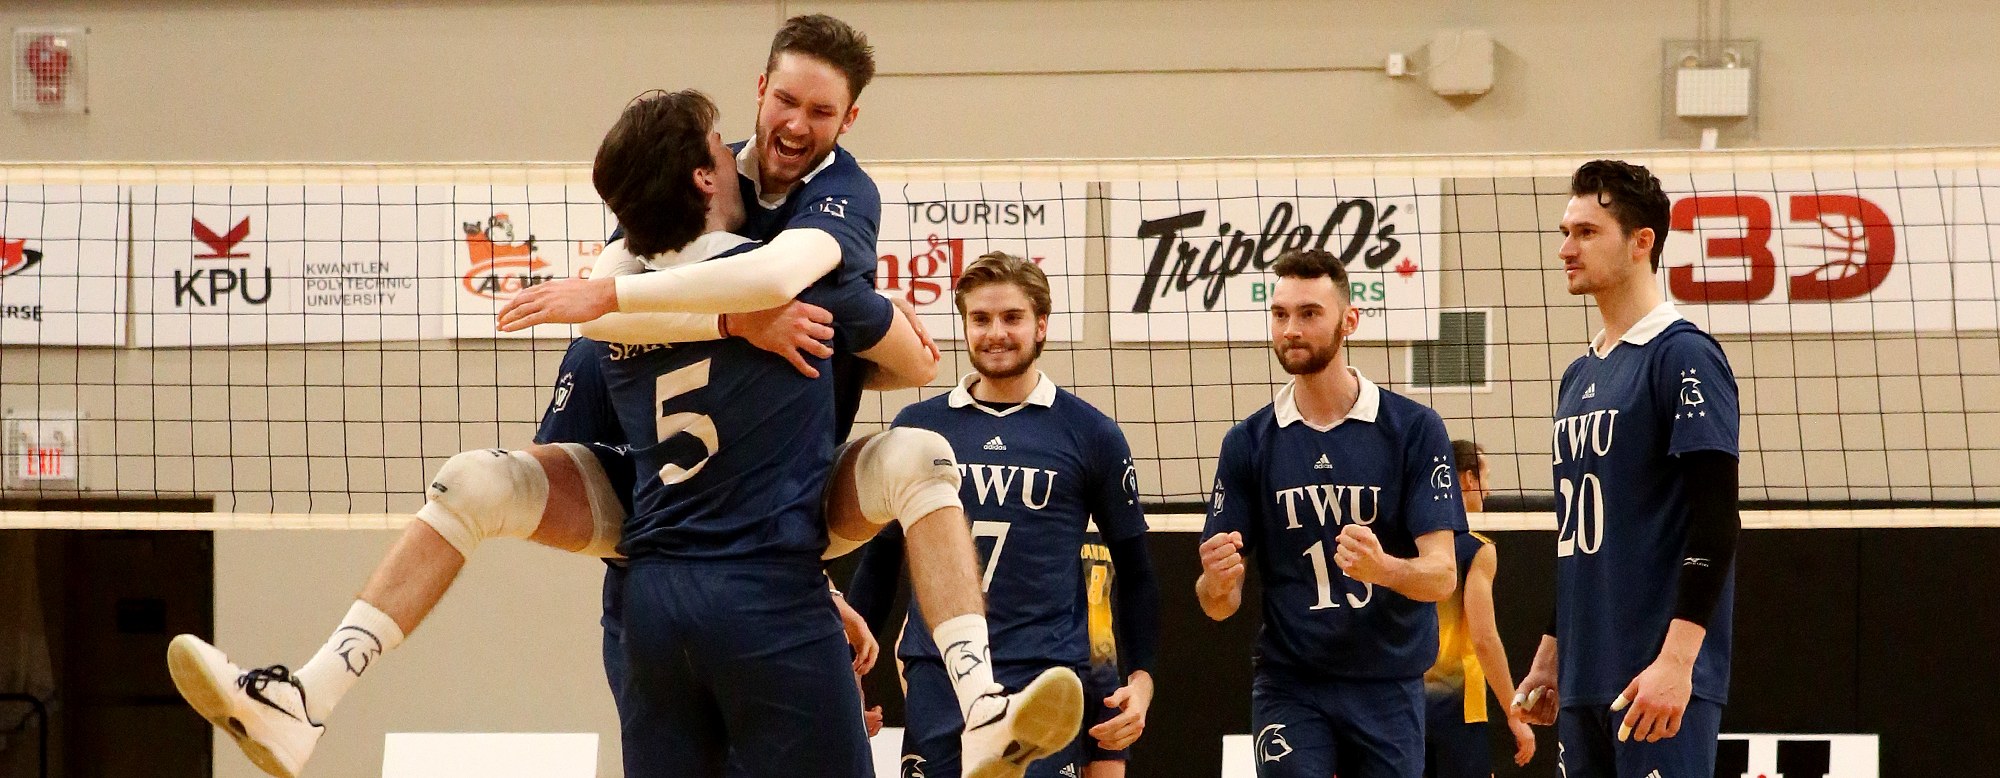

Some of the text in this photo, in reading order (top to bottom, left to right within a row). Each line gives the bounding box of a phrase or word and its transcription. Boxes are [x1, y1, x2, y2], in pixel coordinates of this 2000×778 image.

[908, 203, 1045, 225] TOURISM
[174, 267, 272, 307] KPU
[306, 261, 389, 275] KWANTLEN
[306, 277, 412, 291] POLYTECHNIC
[307, 293, 396, 307] UNIVERSITY
[656, 357, 719, 486] 5
[1553, 409, 1619, 466] TWU
[28, 448, 64, 475] EXIT
[1276, 484, 1381, 530] TWU
[1557, 473, 1604, 558] 20
[971, 520, 1011, 593] 7
